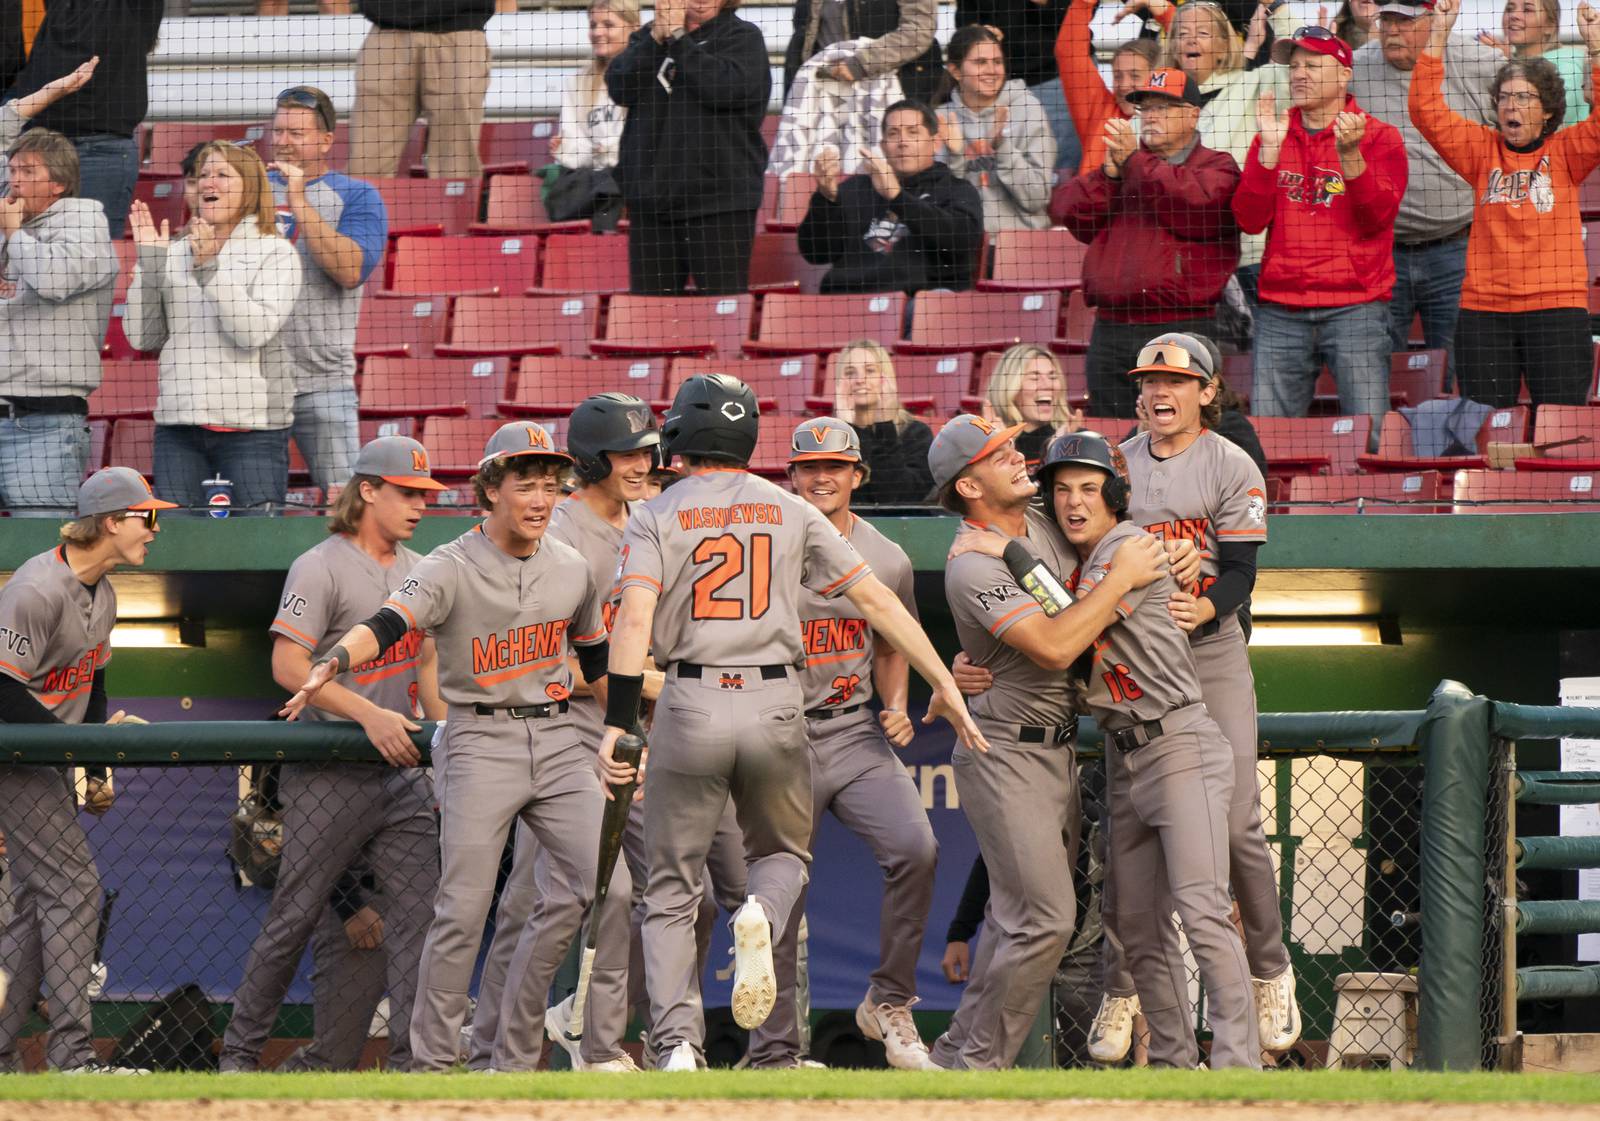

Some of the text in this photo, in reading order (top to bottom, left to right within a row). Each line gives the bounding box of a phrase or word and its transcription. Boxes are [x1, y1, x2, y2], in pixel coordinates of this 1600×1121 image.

[1149, 71, 1168, 88] M
[527, 427, 549, 449] M
[1056, 437, 1083, 457] M
[411, 449, 429, 472] M
[678, 502, 783, 531] WASNIEWSKI
[692, 533, 772, 621] 21
[975, 585, 1019, 612] FVC
[471, 618, 571, 675] McHENR
[1102, 663, 1144, 704] 16
